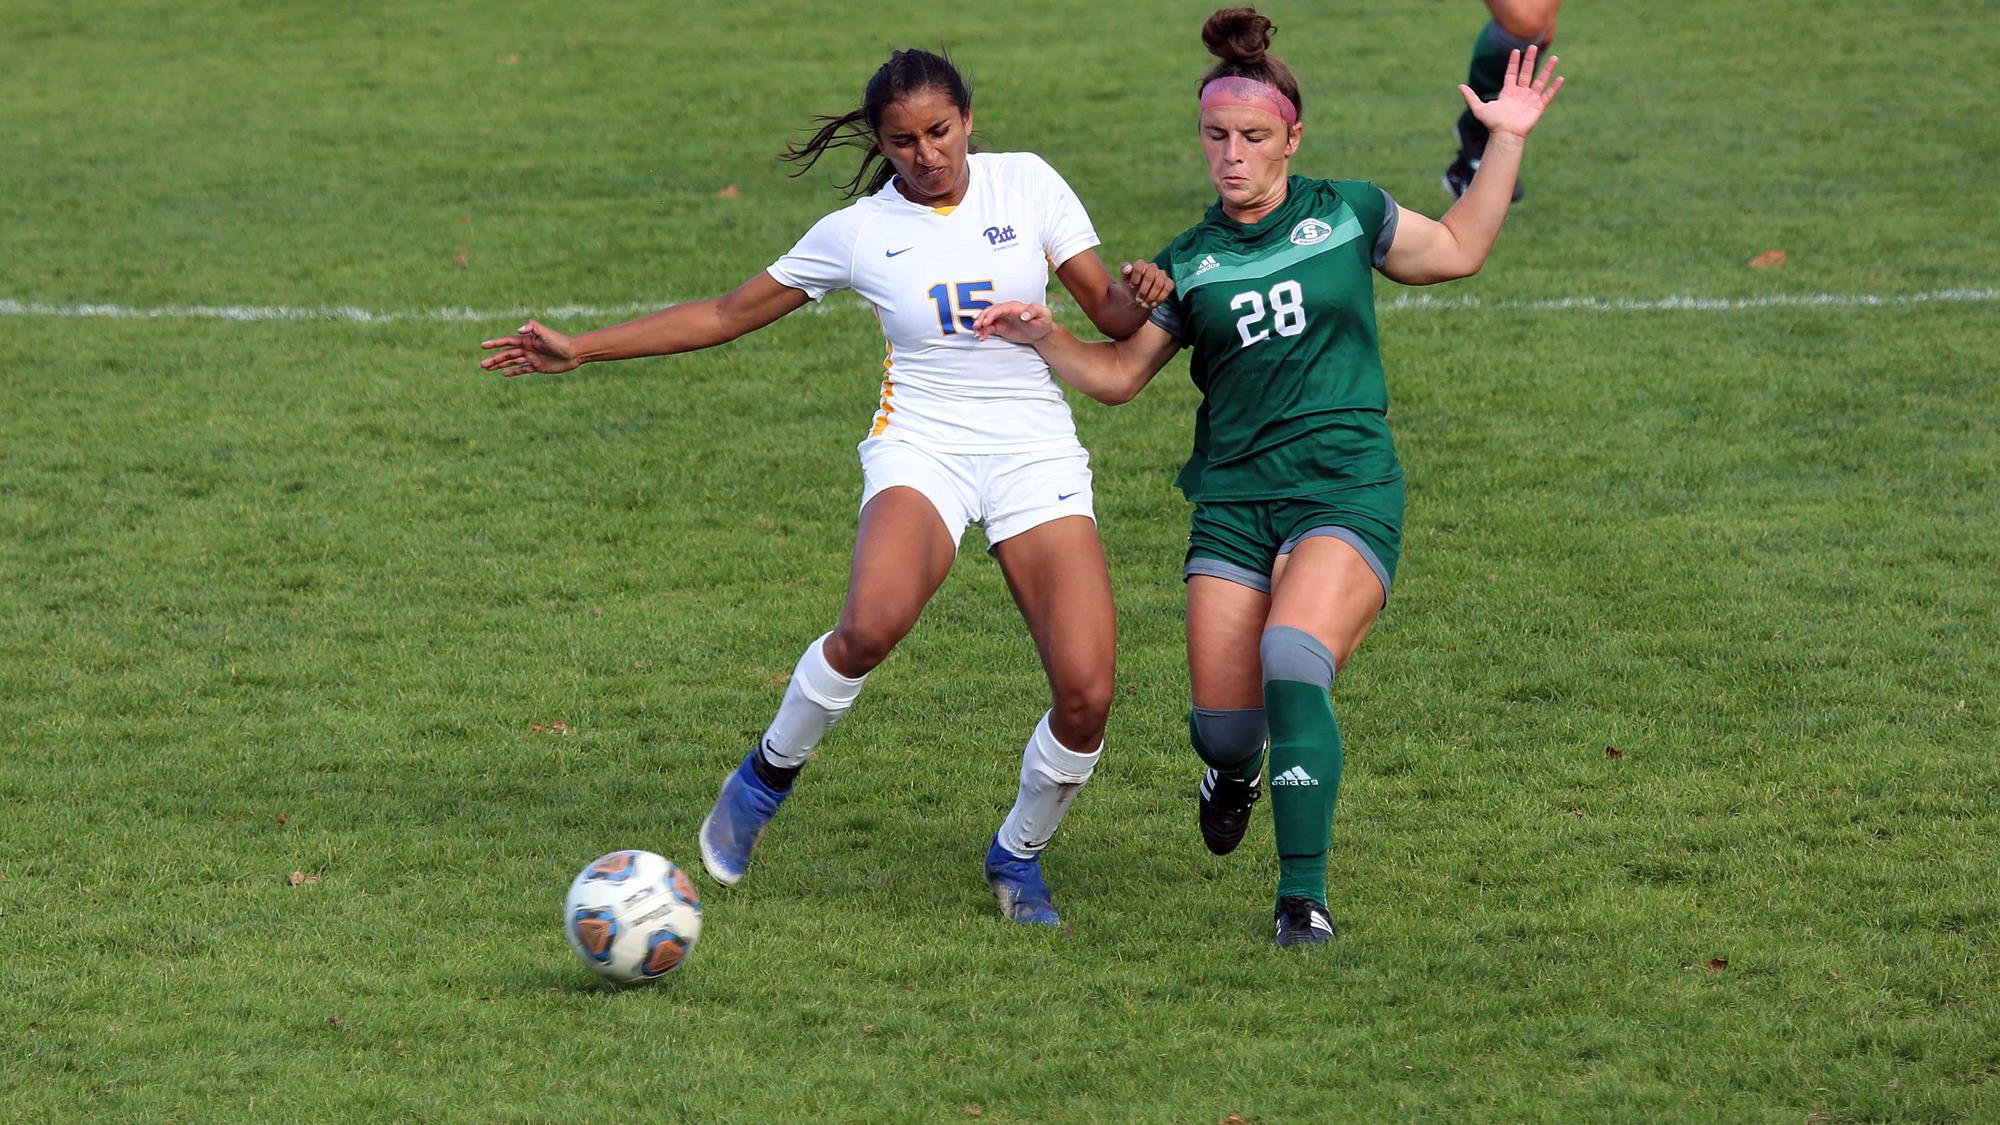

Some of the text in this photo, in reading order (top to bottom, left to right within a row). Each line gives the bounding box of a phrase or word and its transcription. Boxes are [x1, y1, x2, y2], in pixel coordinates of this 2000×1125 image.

[983, 225, 1016, 245] Pitt
[1302, 225, 1318, 239] S
[1196, 262, 1220, 275] adidas
[926, 279, 996, 336] 15
[1230, 280, 1306, 347] 28
